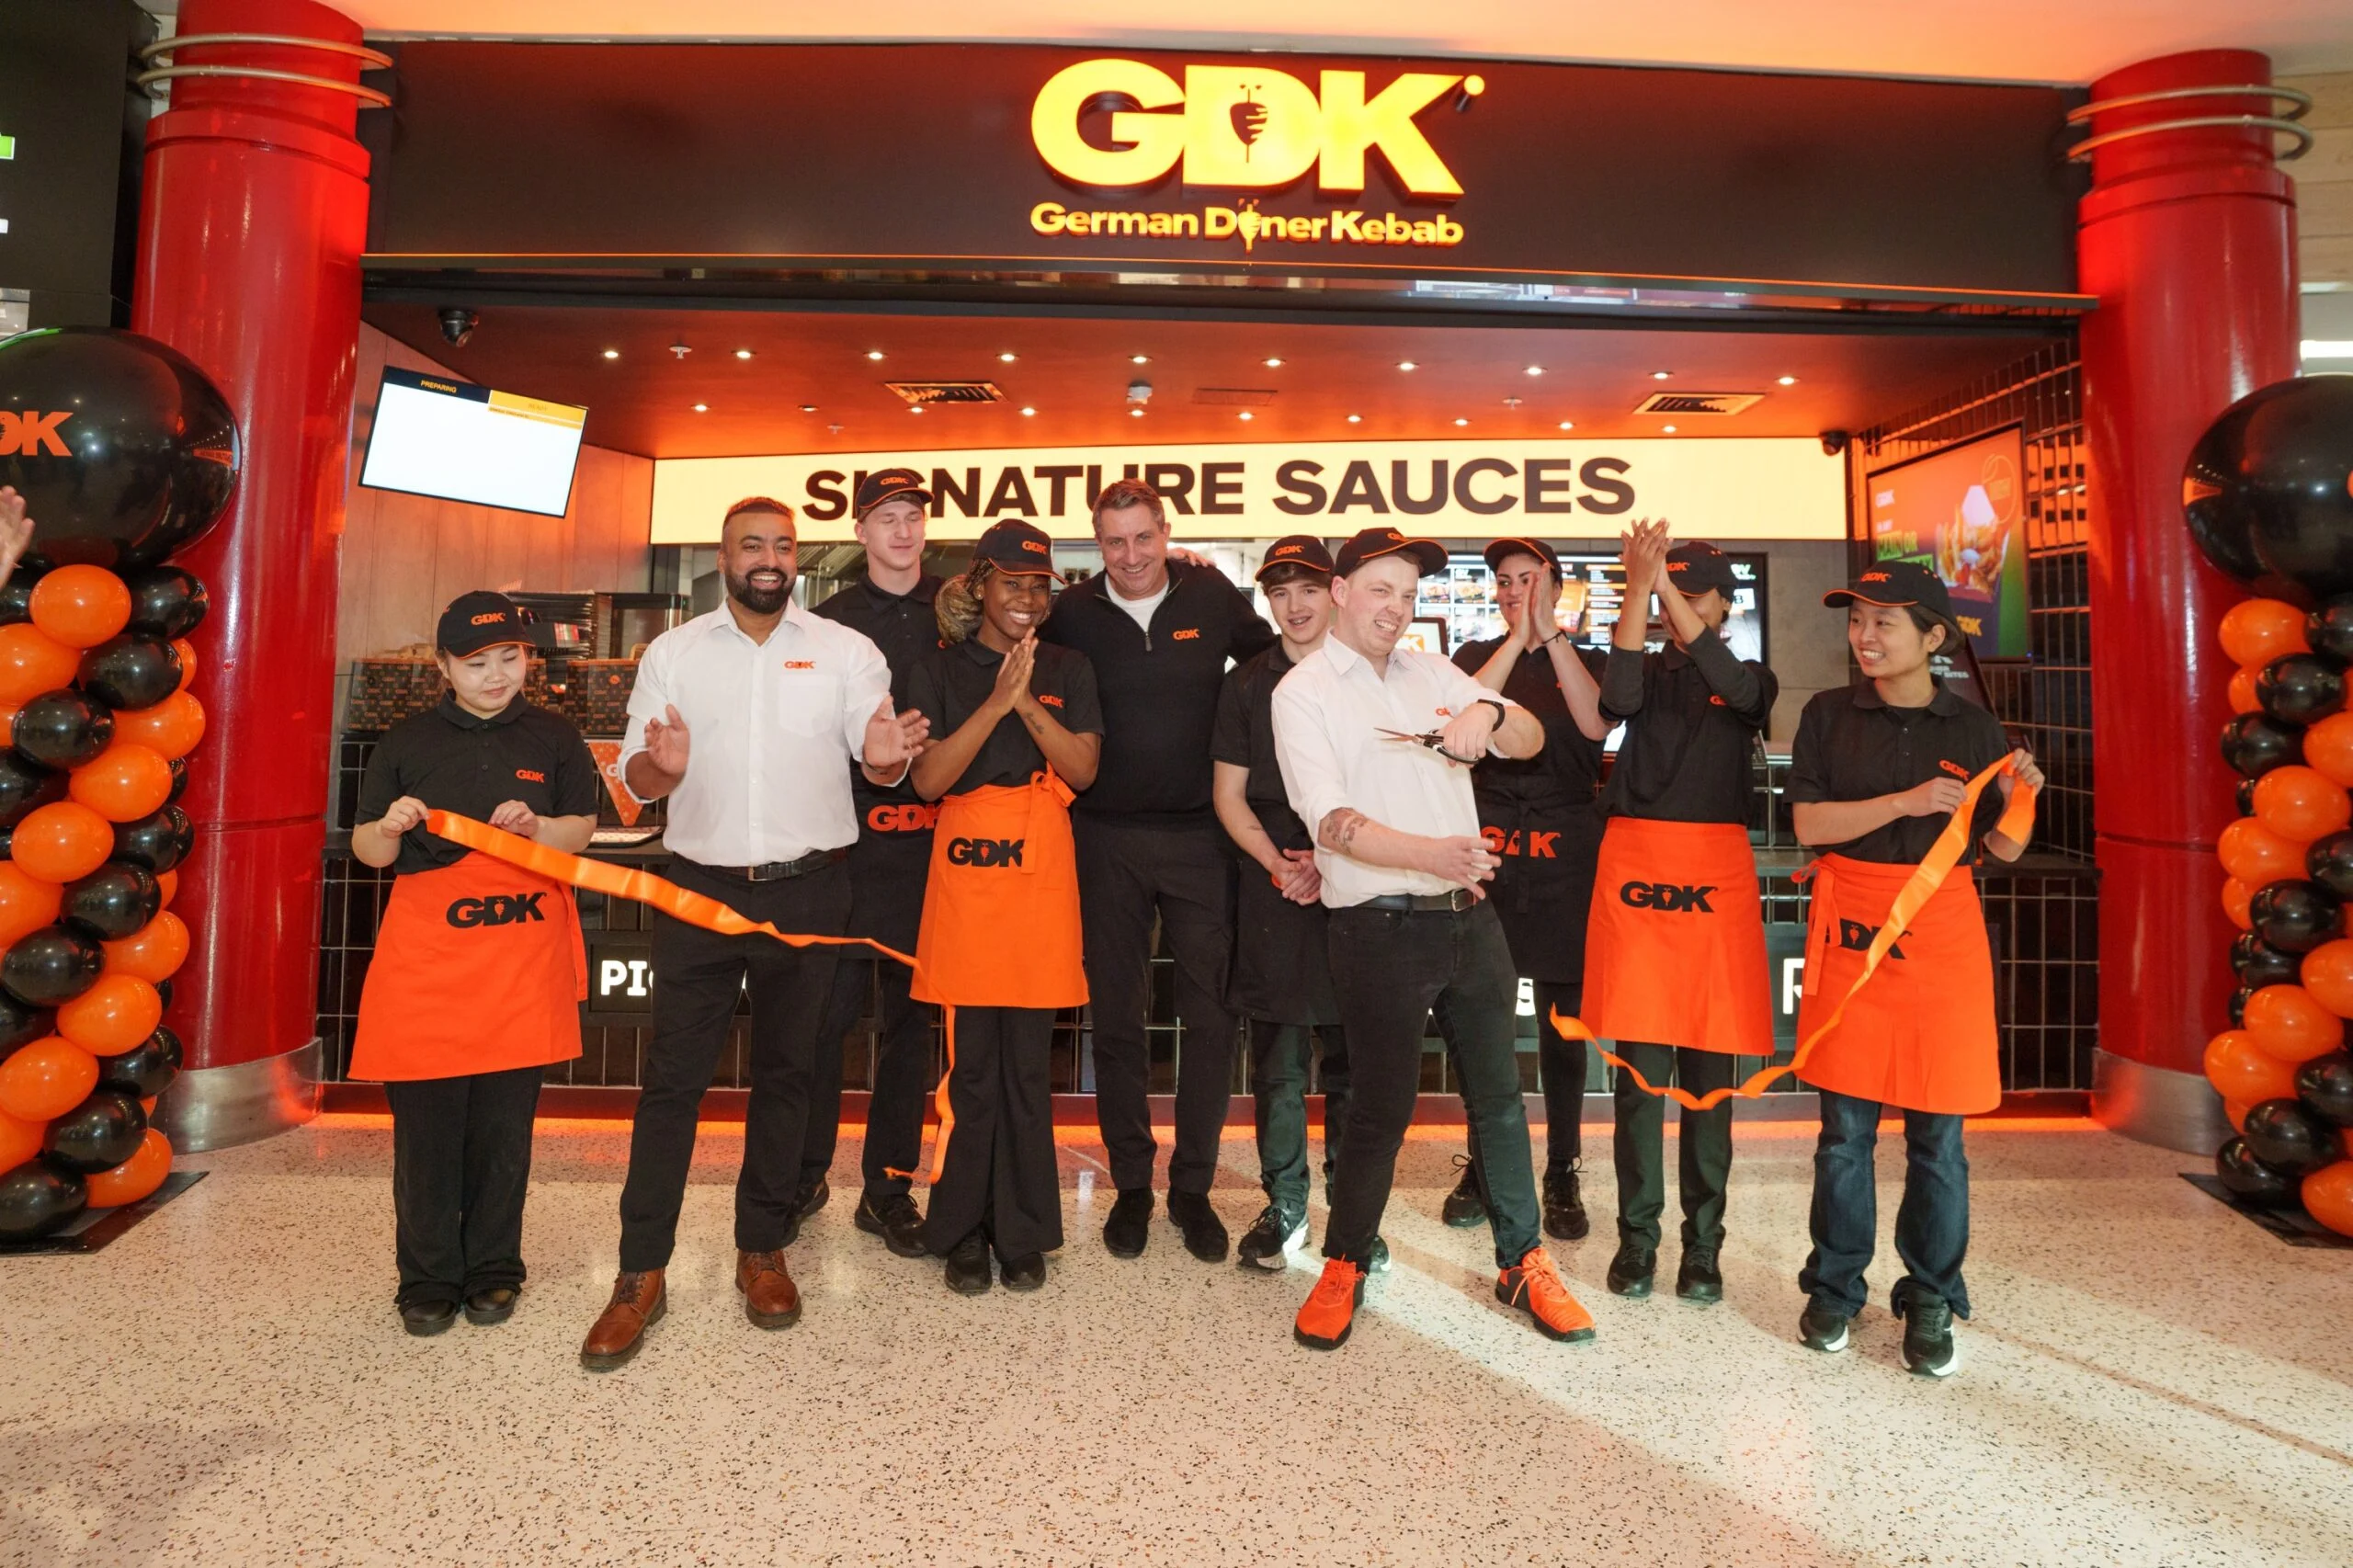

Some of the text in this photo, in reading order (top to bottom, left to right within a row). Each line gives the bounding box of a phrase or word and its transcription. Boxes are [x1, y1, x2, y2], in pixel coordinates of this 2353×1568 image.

[1031, 58, 1465, 195] GDK
[1030, 202, 1199, 237] German
[1331, 210, 1463, 246] Kebab
[420, 380, 458, 394] PREPARING
[1272, 457, 1636, 516] SAUCES
[1022, 540, 1047, 555] GDK
[1275, 544, 1305, 556] GDK
[472, 612, 506, 626] GDK
[1173, 629, 1200, 641] GDK
[784, 661, 816, 669] GDK
[1040, 695, 1064, 709] GDK
[516, 769, 545, 783] GDK
[1620, 881, 1717, 913] GDK
[447, 892, 546, 928] GDK
